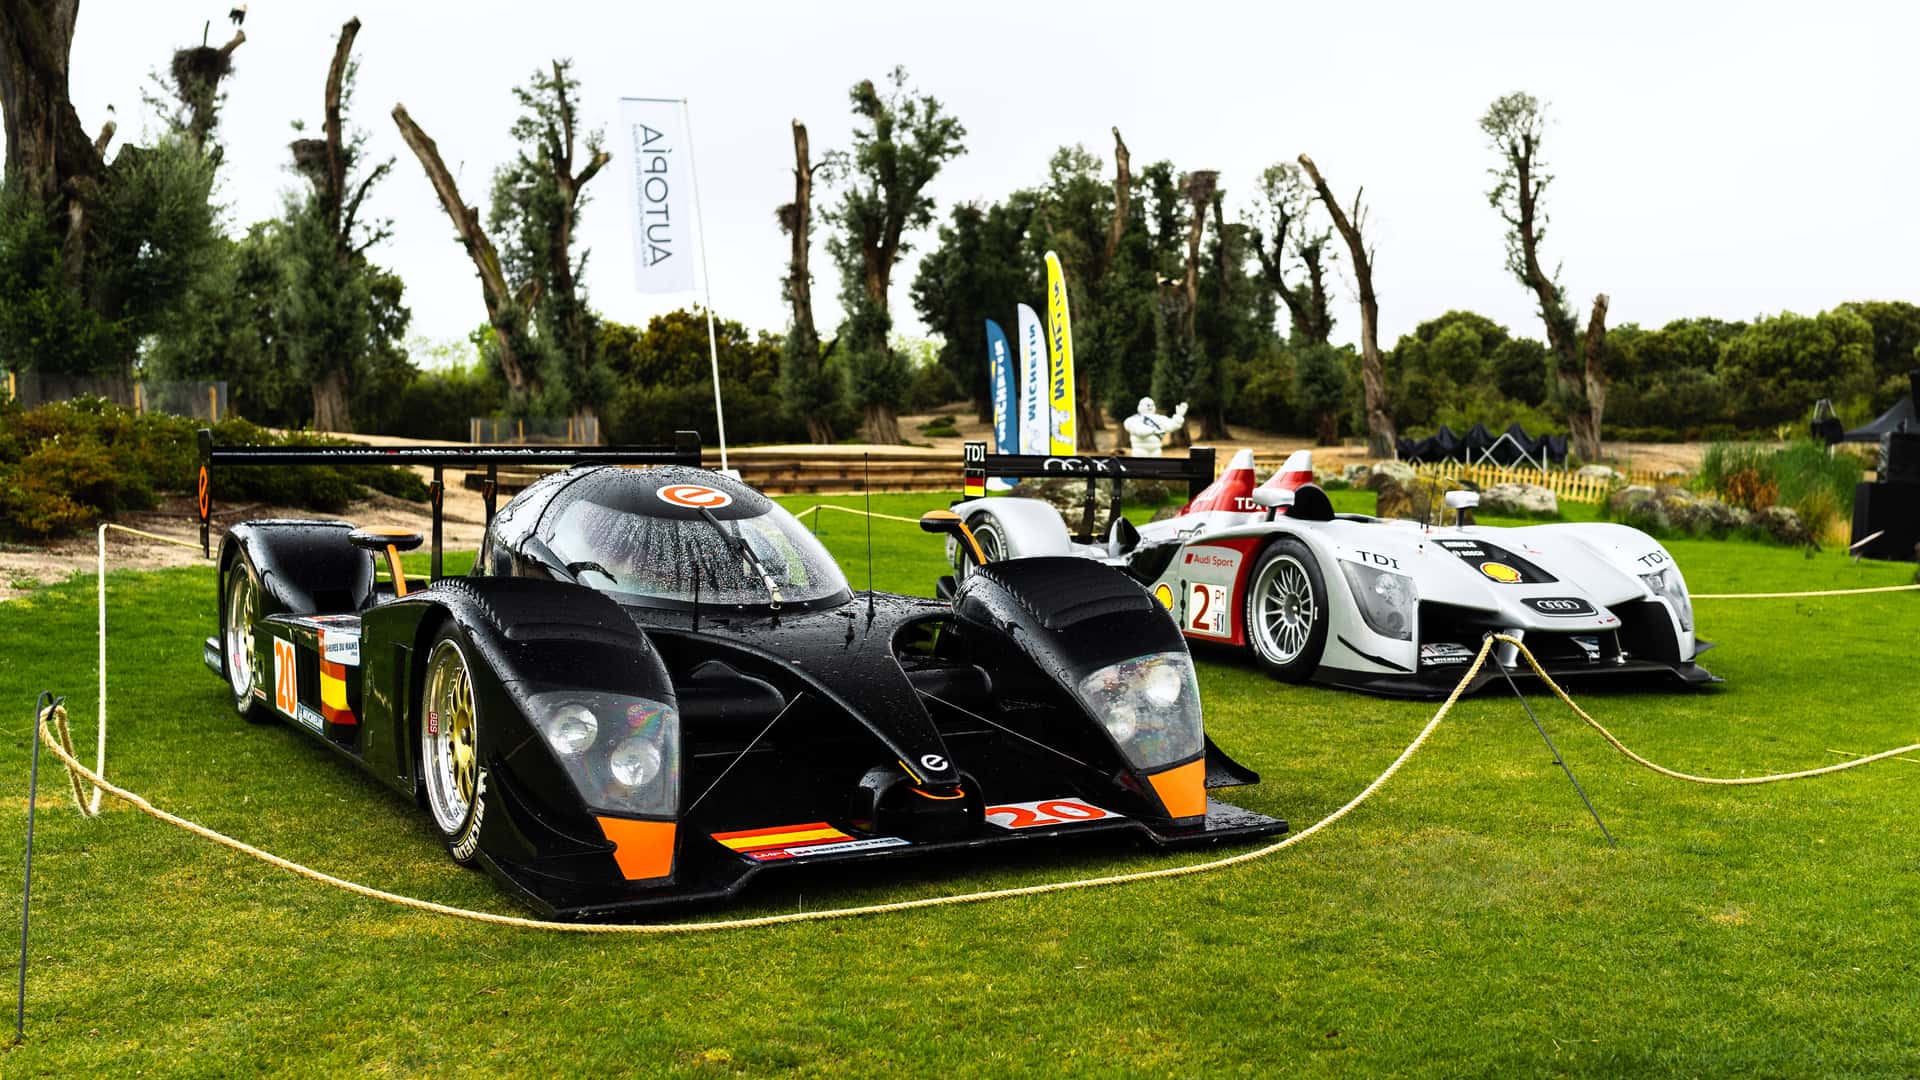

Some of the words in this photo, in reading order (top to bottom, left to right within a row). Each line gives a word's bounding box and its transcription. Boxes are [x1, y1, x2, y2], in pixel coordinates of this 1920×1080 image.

[965, 444, 985, 462] TDI
[1193, 554, 1211, 564] Audi
[1213, 555, 1234, 568] Sport
[1355, 550, 1400, 570] TDI
[1637, 550, 1669, 567] TDI
[1192, 584, 1210, 631] 2
[1215, 589, 1225, 606] P1
[275, 640, 296, 715] 20
[985, 800, 1107, 828] 20
[453, 796, 485, 860] MICHELIN
